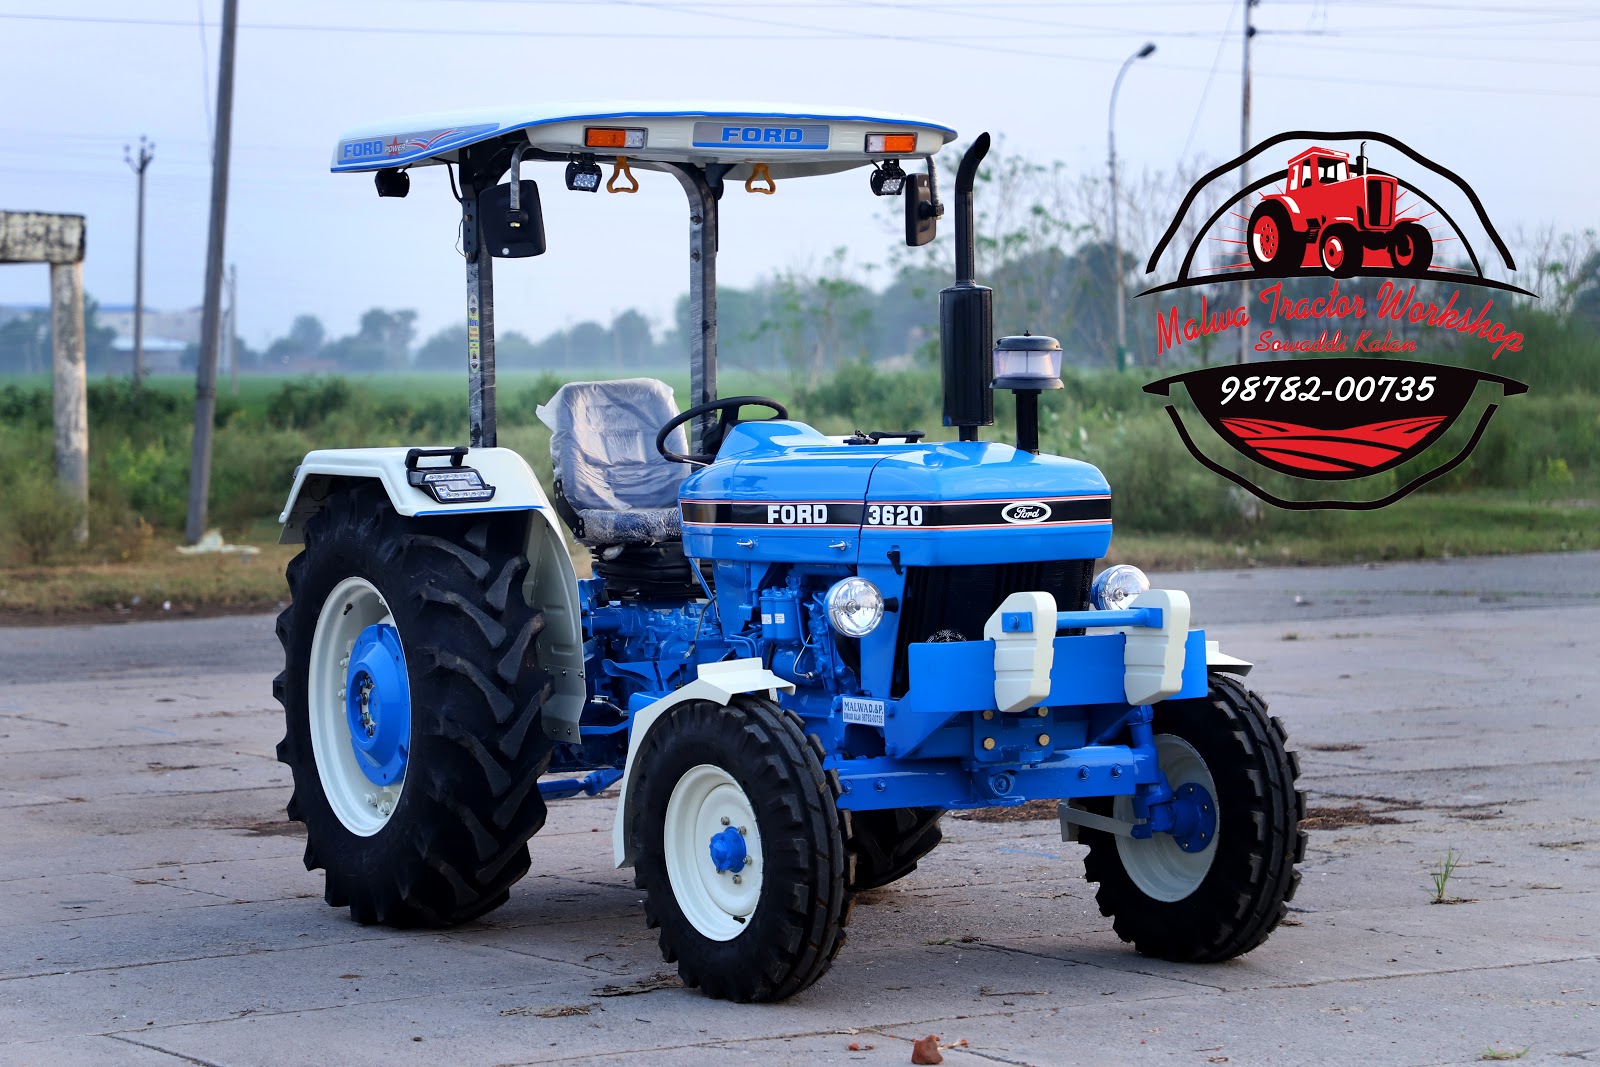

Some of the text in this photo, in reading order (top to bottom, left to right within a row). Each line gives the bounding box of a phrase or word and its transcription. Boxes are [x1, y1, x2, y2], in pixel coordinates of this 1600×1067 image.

[722, 127, 804, 143] FORD
[343, 140, 383, 158] FORD
[767, 504, 923, 526] FORD 3620
[1013, 506, 1041, 519] Ford
